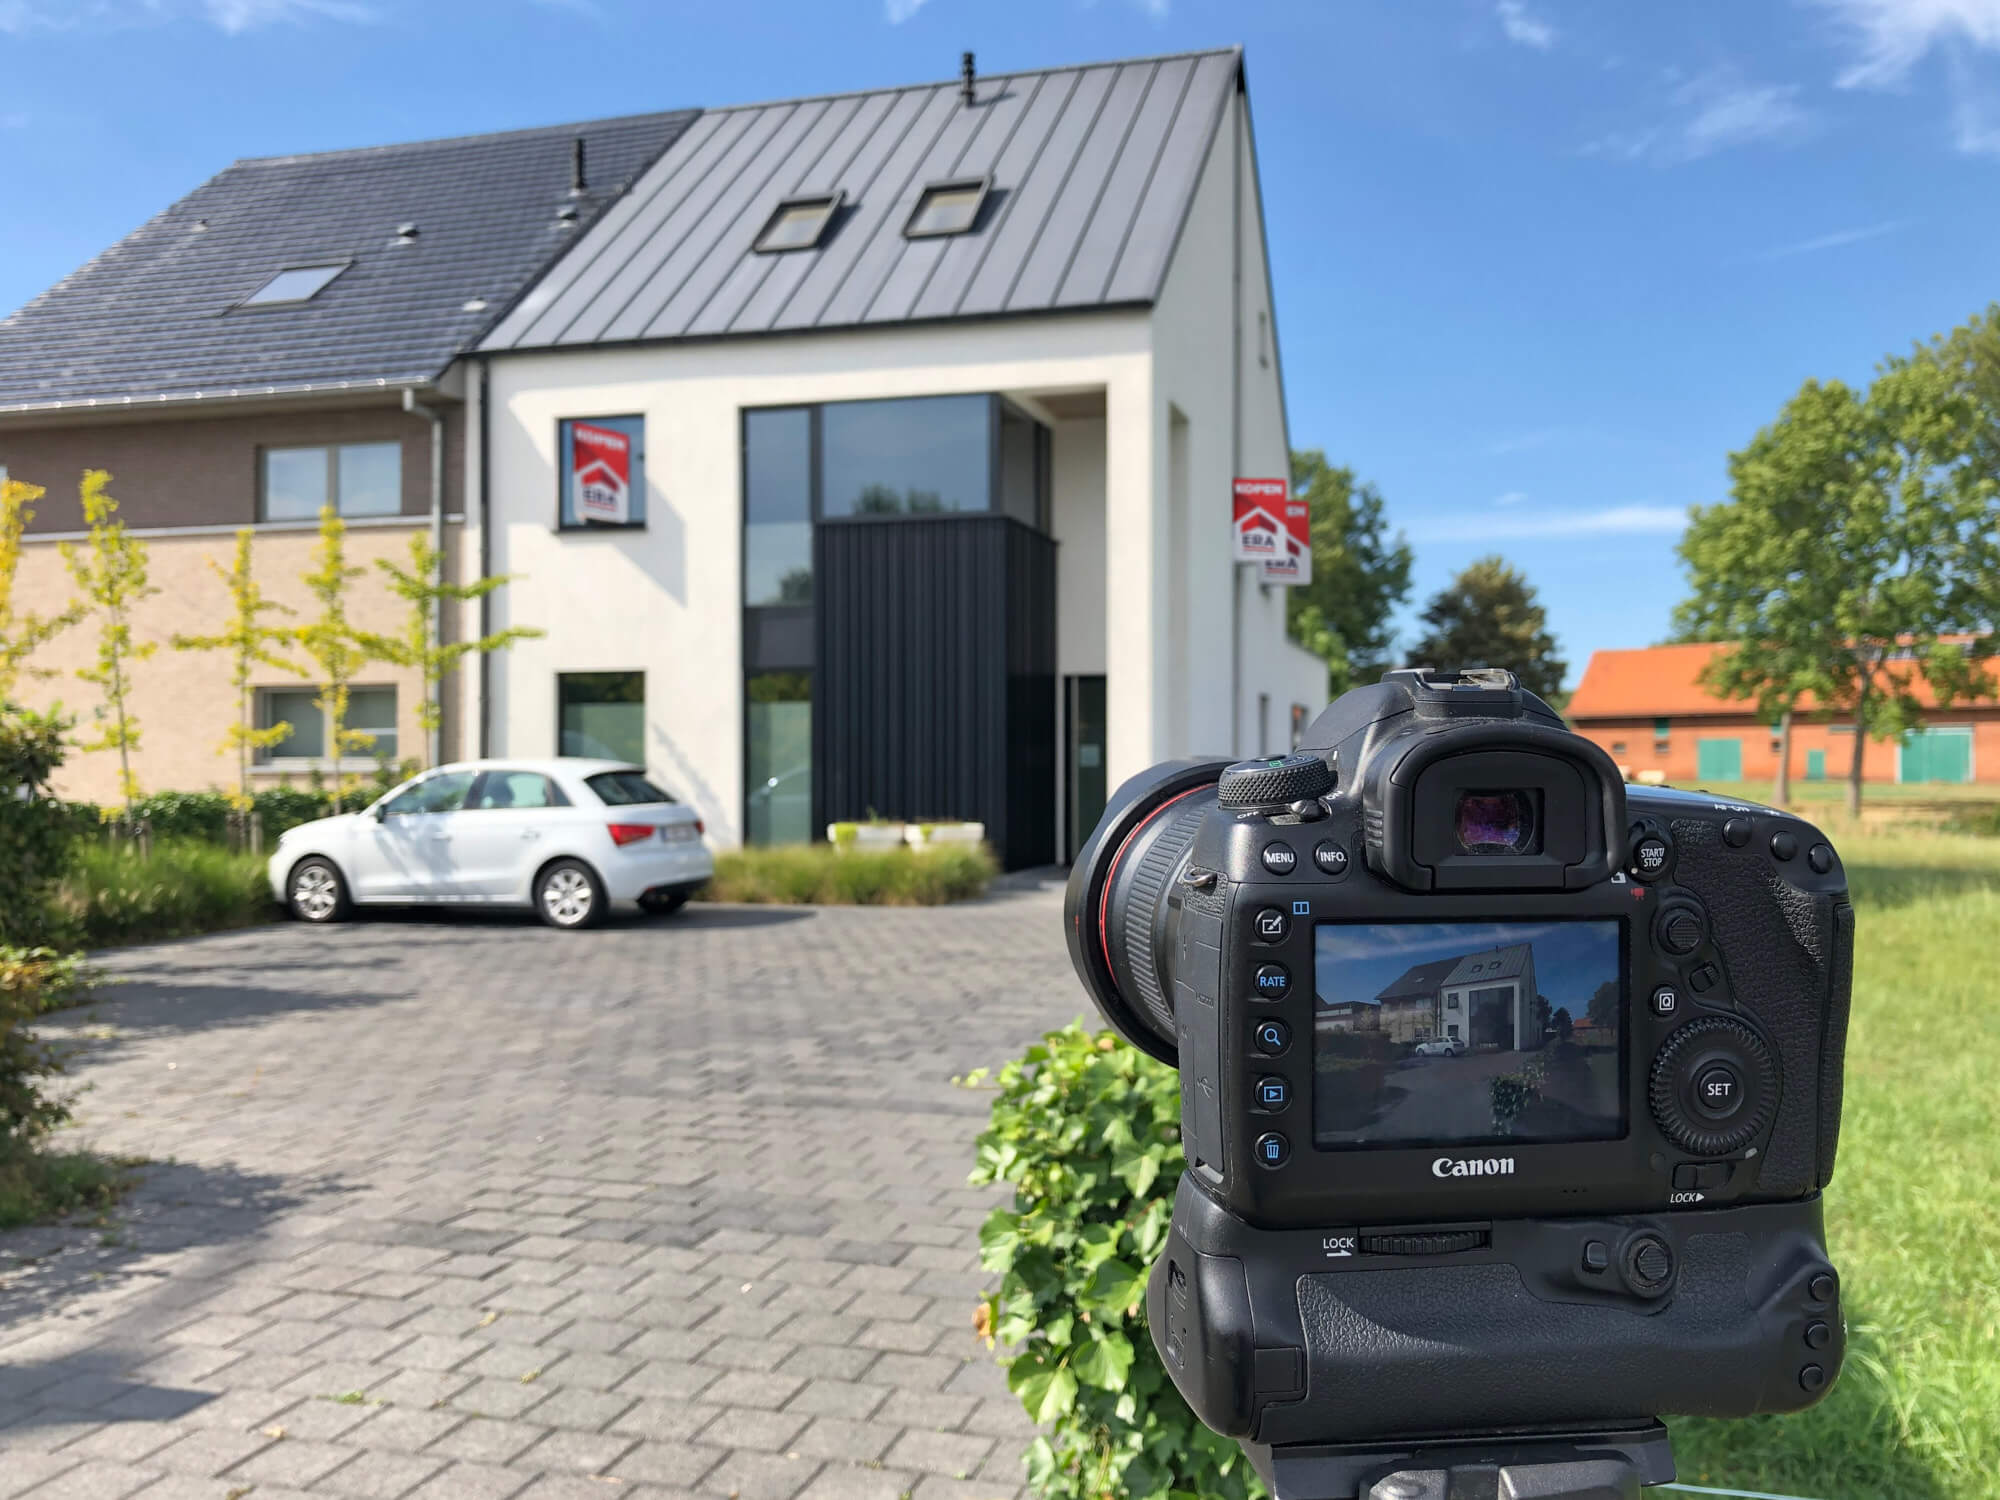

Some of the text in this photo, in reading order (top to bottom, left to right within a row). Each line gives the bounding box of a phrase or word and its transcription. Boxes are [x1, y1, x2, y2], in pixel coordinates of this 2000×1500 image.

[1242, 534, 1275, 547] ERA
[1236, 810, 1260, 820] OFF
[1266, 852, 1294, 863] MENU
[1320, 851, 1347, 863] INFO.
[1643, 858, 1663, 868] STOP
[1259, 975, 1286, 988] RATE
[1707, 1083, 1731, 1096] SET
[1431, 1157, 1515, 1178] Canon
[1670, 1192, 1697, 1203] LOCK
[1323, 1237, 1355, 1249] LOCK
